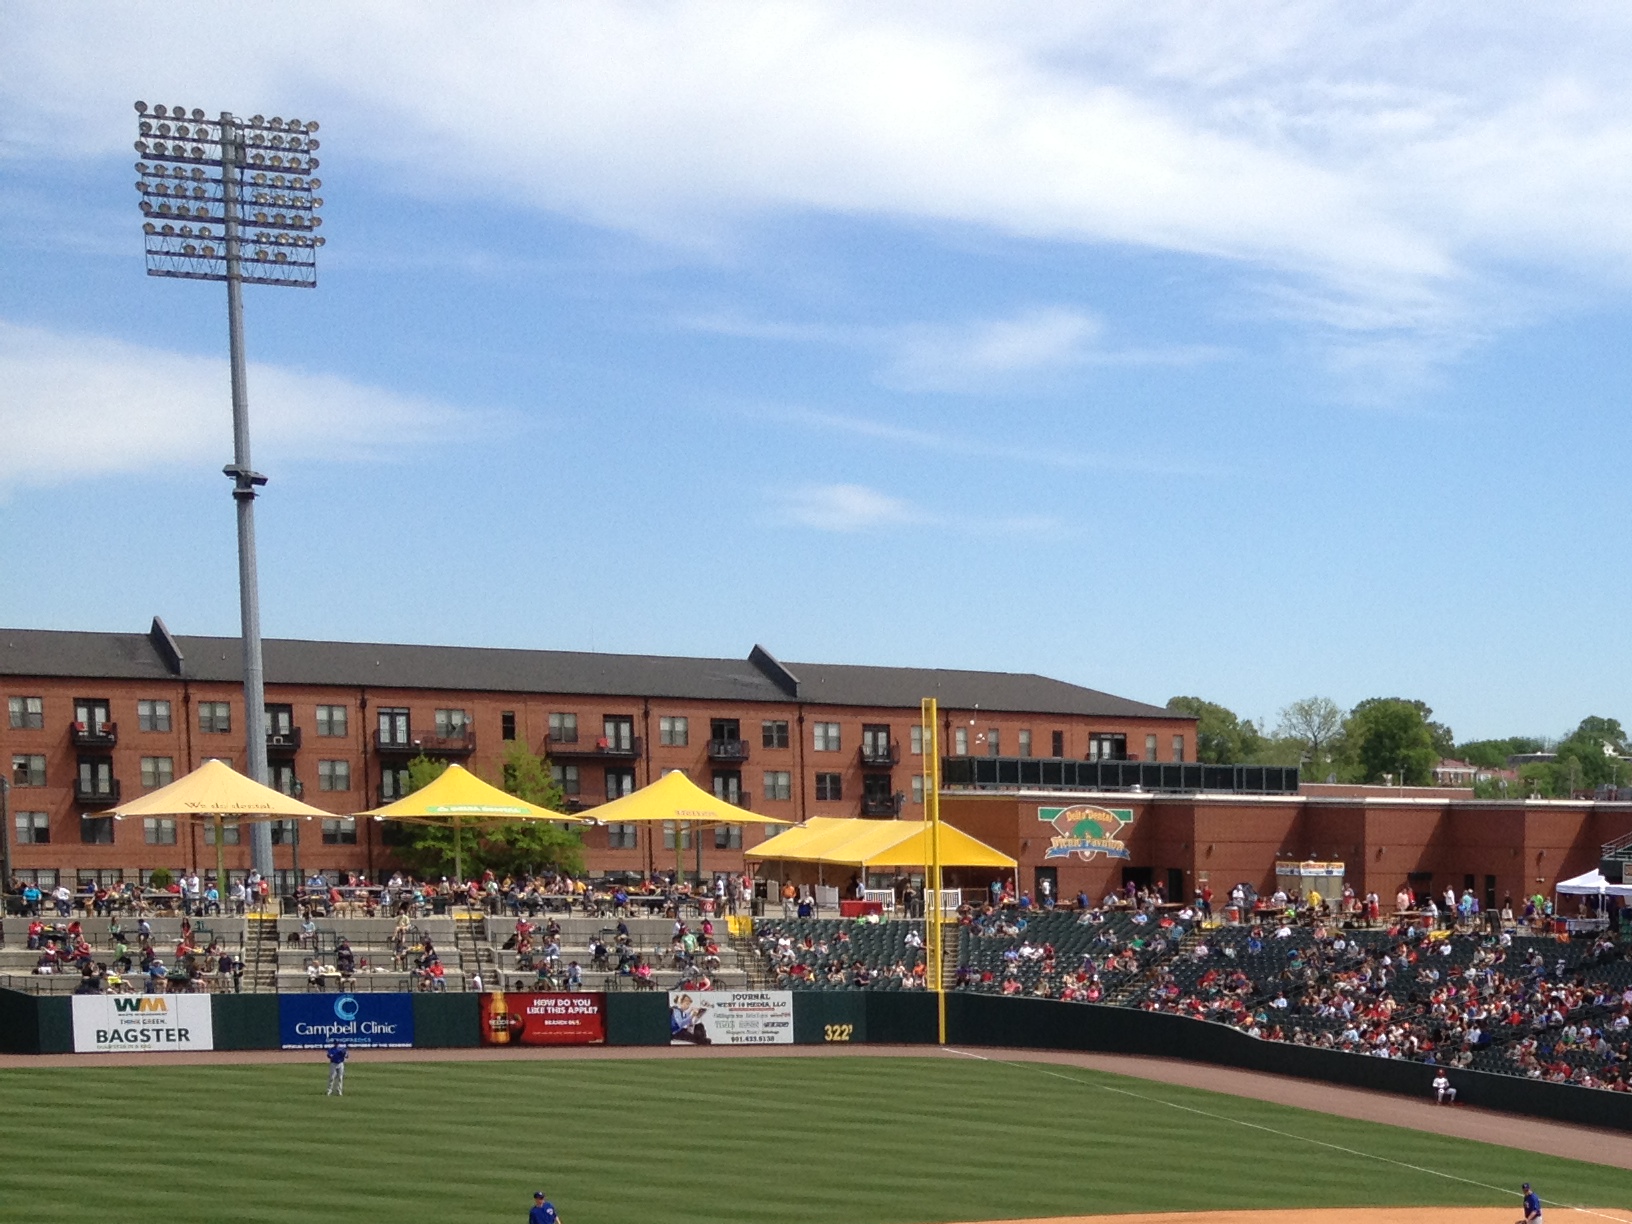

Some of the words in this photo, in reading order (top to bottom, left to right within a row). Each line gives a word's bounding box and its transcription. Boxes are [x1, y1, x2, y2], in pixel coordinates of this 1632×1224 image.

[114, 998, 168, 1012] WM
[526, 1006, 545, 1014] LIKE
[547, 1006, 566, 1014] THIS
[568, 1006, 598, 1014] APPLE?
[96, 1028, 190, 1043] BAGSTER
[295, 1021, 357, 1038] Campbell
[361, 1021, 396, 1034] Clinic
[824, 1024, 853, 1041] 322'
